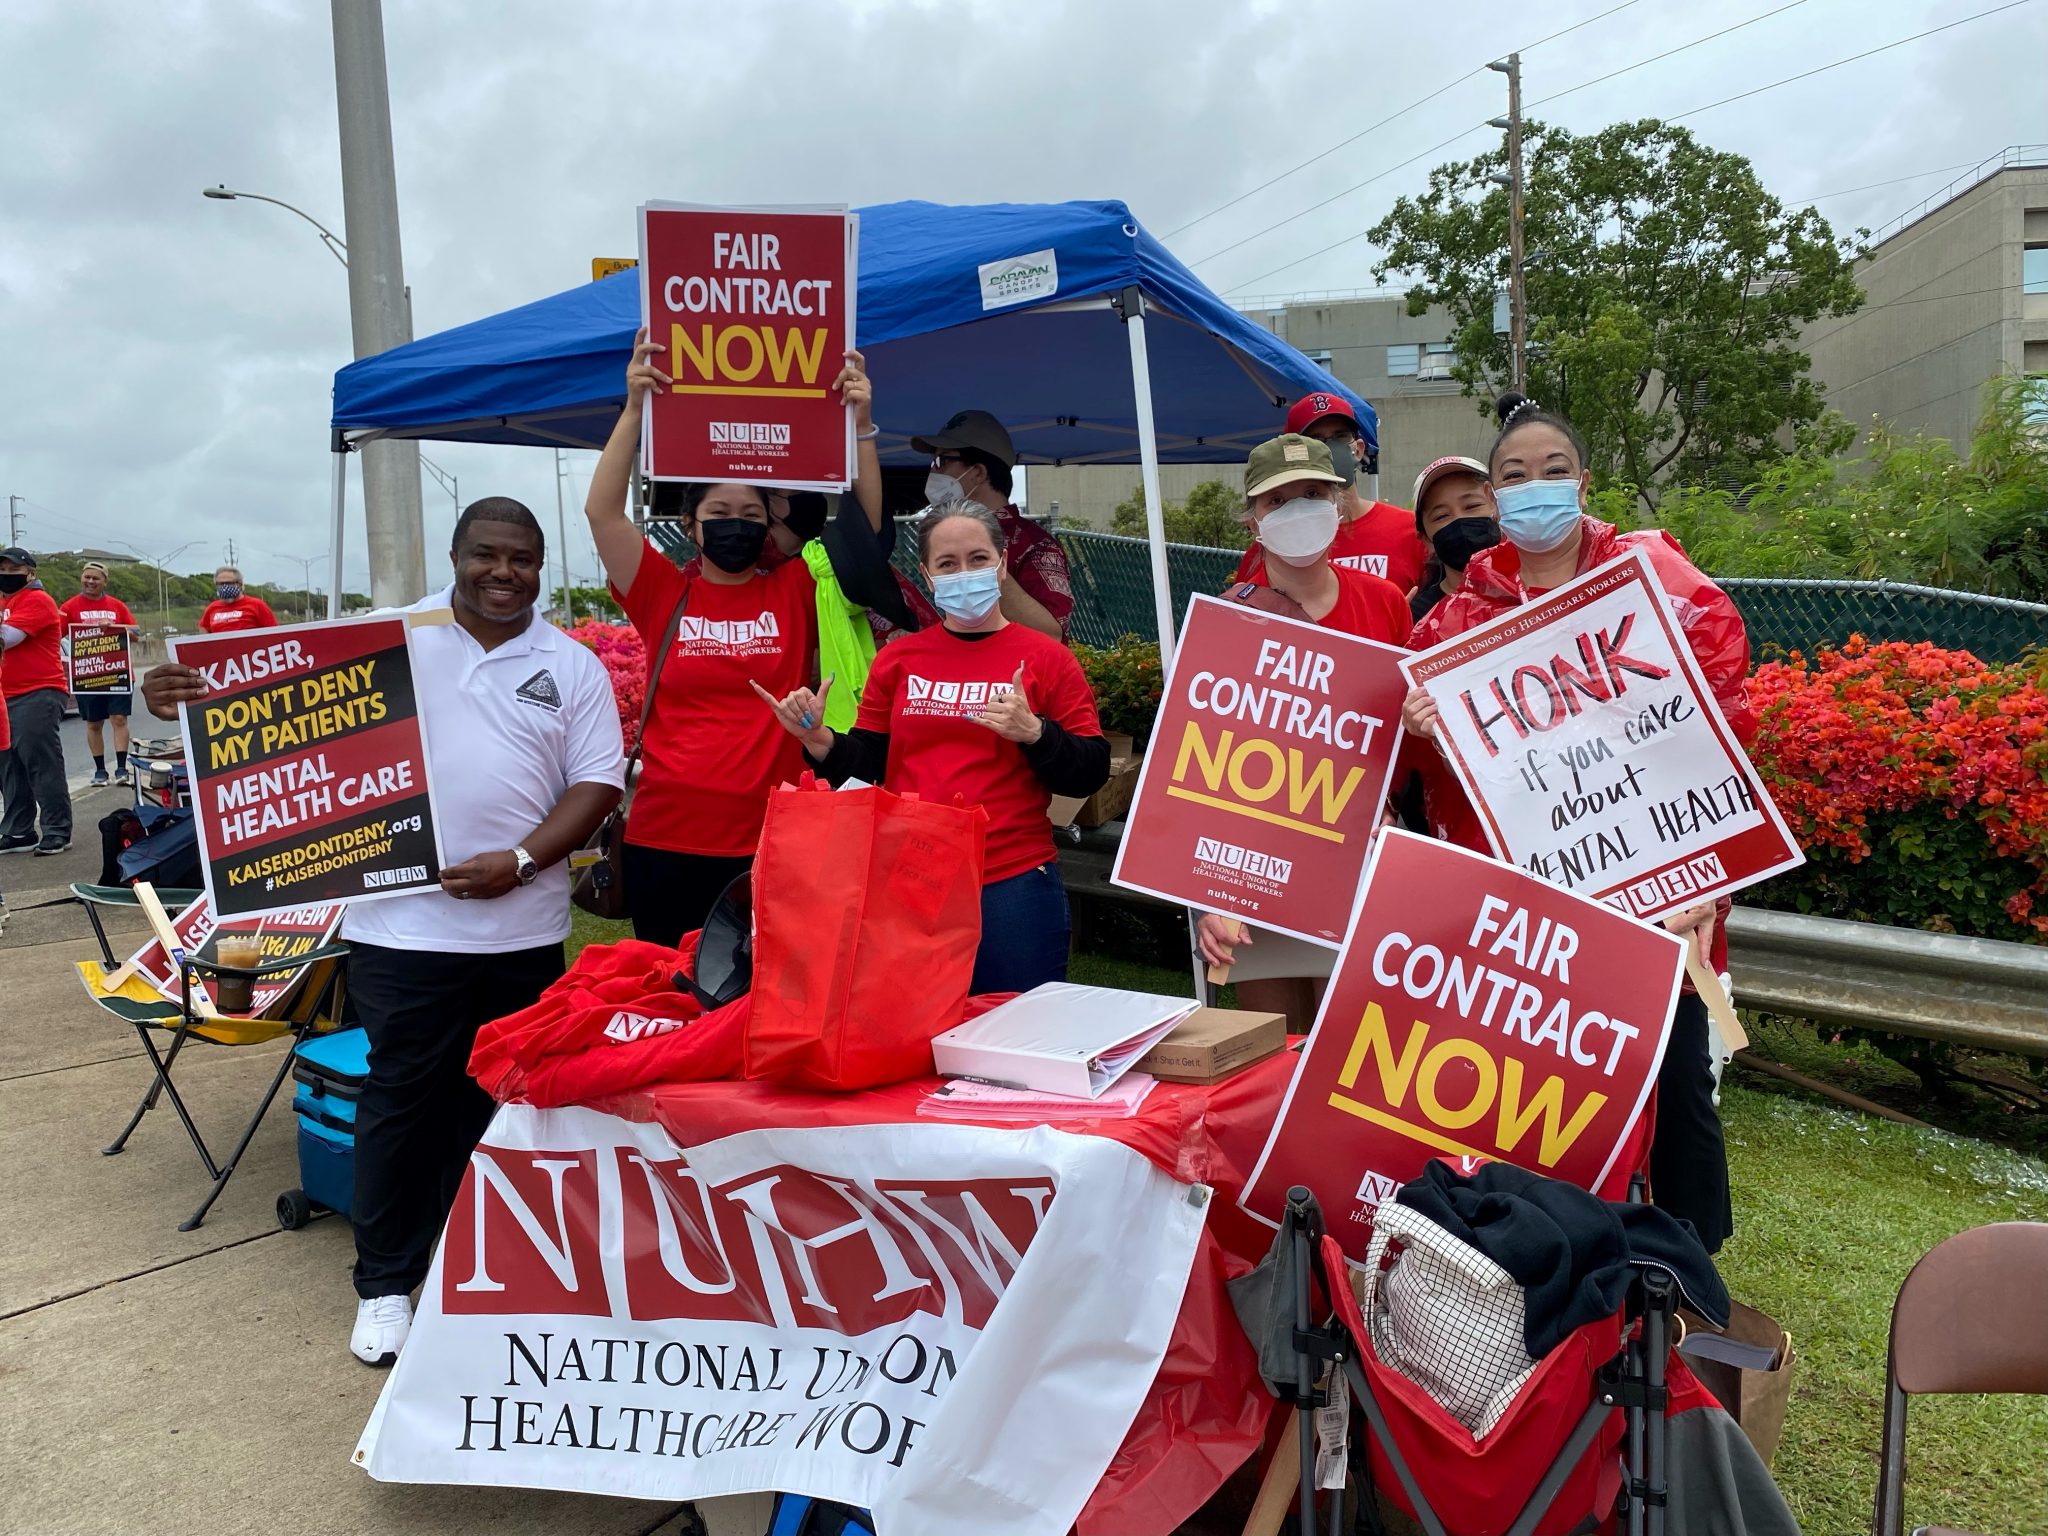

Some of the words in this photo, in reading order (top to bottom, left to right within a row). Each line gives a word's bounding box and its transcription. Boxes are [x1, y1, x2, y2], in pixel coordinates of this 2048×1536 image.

[713, 232, 781, 271] FAIR
[664, 275, 832, 316] CONTRACT
[998, 277, 1040, 290] CANOPY
[999, 282, 1041, 296] SPORTS
[671, 323, 829, 384] NOW
[710, 423, 789, 442] NUHW
[711, 448, 756, 456] HEALTHCARE
[757, 449, 789, 457] WORKERS
[752, 443, 775, 451] UNION
[728, 463, 773, 472] nuhw.org
[74, 627, 104, 639] KAISER,
[99, 635, 119, 645] DENY
[680, 612, 776, 643] NUHW
[1416, 648, 1468, 677] NATIONAL
[1468, 633, 1503, 654] UNION
[1504, 625, 1516, 637] OF
[1518, 592, 1586, 632] HEALTHCARE
[1585, 566, 1635, 597] WORKERS
[74, 648, 86, 657] MY
[87, 643, 121, 655] PATIENTS
[74, 656, 106, 668] MENTAL
[199, 640, 314, 691] KAISER,
[678, 648, 737, 657] HEALTHCARE
[739, 646, 782, 657] WORKERS
[685, 640, 729, 650] NATIONAL
[731, 639, 762, 652] UNION
[1254, 638, 1335, 695] FAIR
[75, 664, 105, 676] HEALTH
[105, 660, 126, 671] CARE
[908, 676, 1014, 702] NUHW
[1459, 612, 1672, 758] HONK
[205, 684, 294, 737] DON'T
[301, 660, 376, 708] DENY
[902, 707, 961, 717] HEALTHCARE
[909, 700, 956, 709] NATIONAL
[1188, 671, 1384, 755] CONTRACT
[210, 730, 254, 770] MY
[261, 691, 387, 754] PATIENTS
[1513, 749, 1549, 793] if
[1557, 737, 1615, 795] you
[1624, 695, 1696, 745] care
[216, 753, 336, 814] MENTAL
[1171, 720, 1367, 825] NOW
[220, 785, 333, 846] HEALTH
[337, 760, 413, 803] CARE
[1551, 763, 1647, 831] about
[1648, 772, 1758, 843] HEALTH
[228, 814, 422, 887] KAISERDONTDENY.org
[265, 838, 393, 892] #KAISERDONTDENY
[1196, 838, 1291, 881] NUHW
[364, 865, 427, 888] NUHW
[1192, 866, 1244, 887] HEALTHCARE
[1246, 881, 1284, 898] WORKERS
[1199, 861, 1240, 878] NATIONAL
[1242, 872, 1268, 886] UNION
[1268, 881, 1280, 889] OF
[1207, 888, 1260, 911] nuhw.org
[1467, 893, 1580, 985] FAIR
[1371, 931, 1640, 1077] CONTRACT
[1336, 1000, 1609, 1169] NOW
[456, 1150, 1052, 1314] NUHW
[503, 1333, 789, 1392] NATIONAL
[804, 1333, 958, 1400] UNON
[455, 1395, 797, 1459] HEALTHCARE
